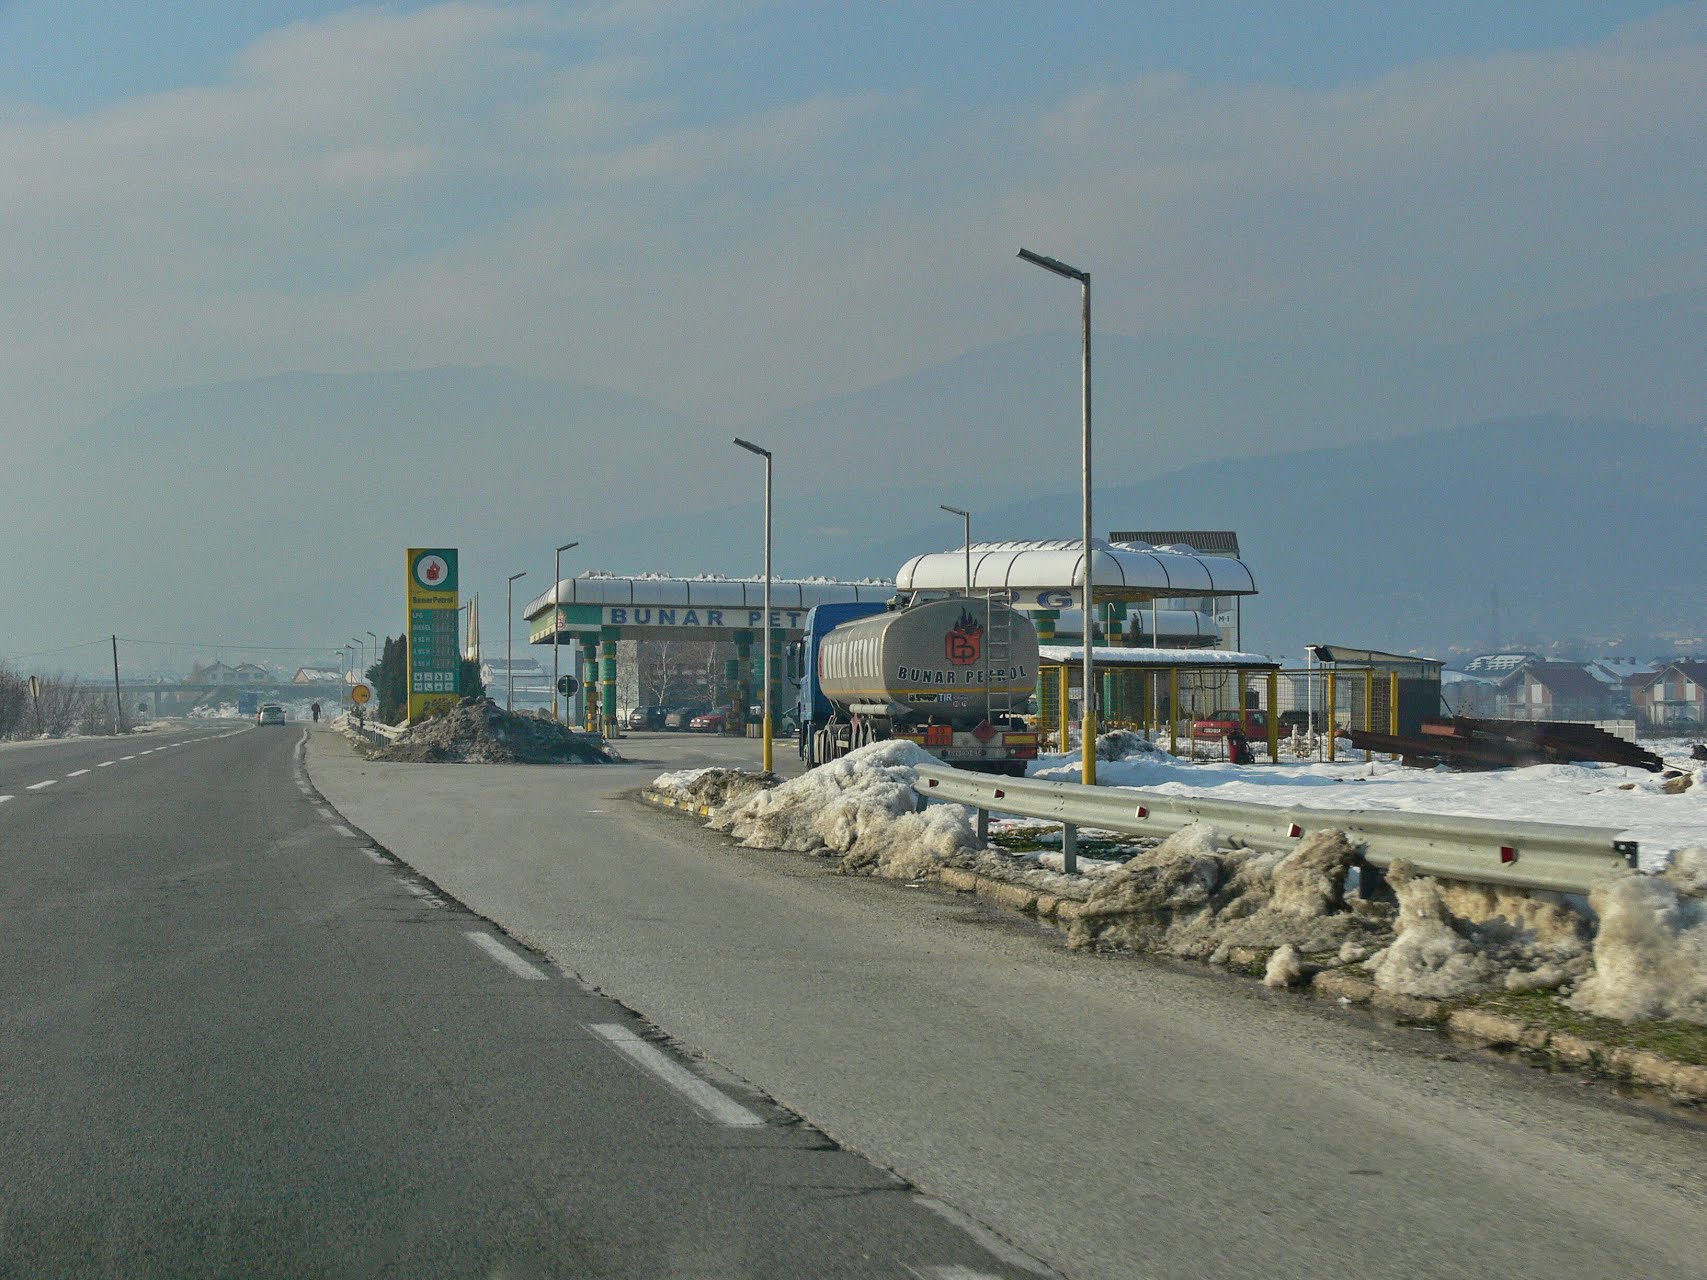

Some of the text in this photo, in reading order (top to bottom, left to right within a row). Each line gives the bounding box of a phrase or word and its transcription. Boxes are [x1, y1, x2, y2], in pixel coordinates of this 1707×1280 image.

[611, 608, 724, 626] BUNAR
[898, 666, 956, 683] BUNAR
[938, 693, 953, 702] TIR
